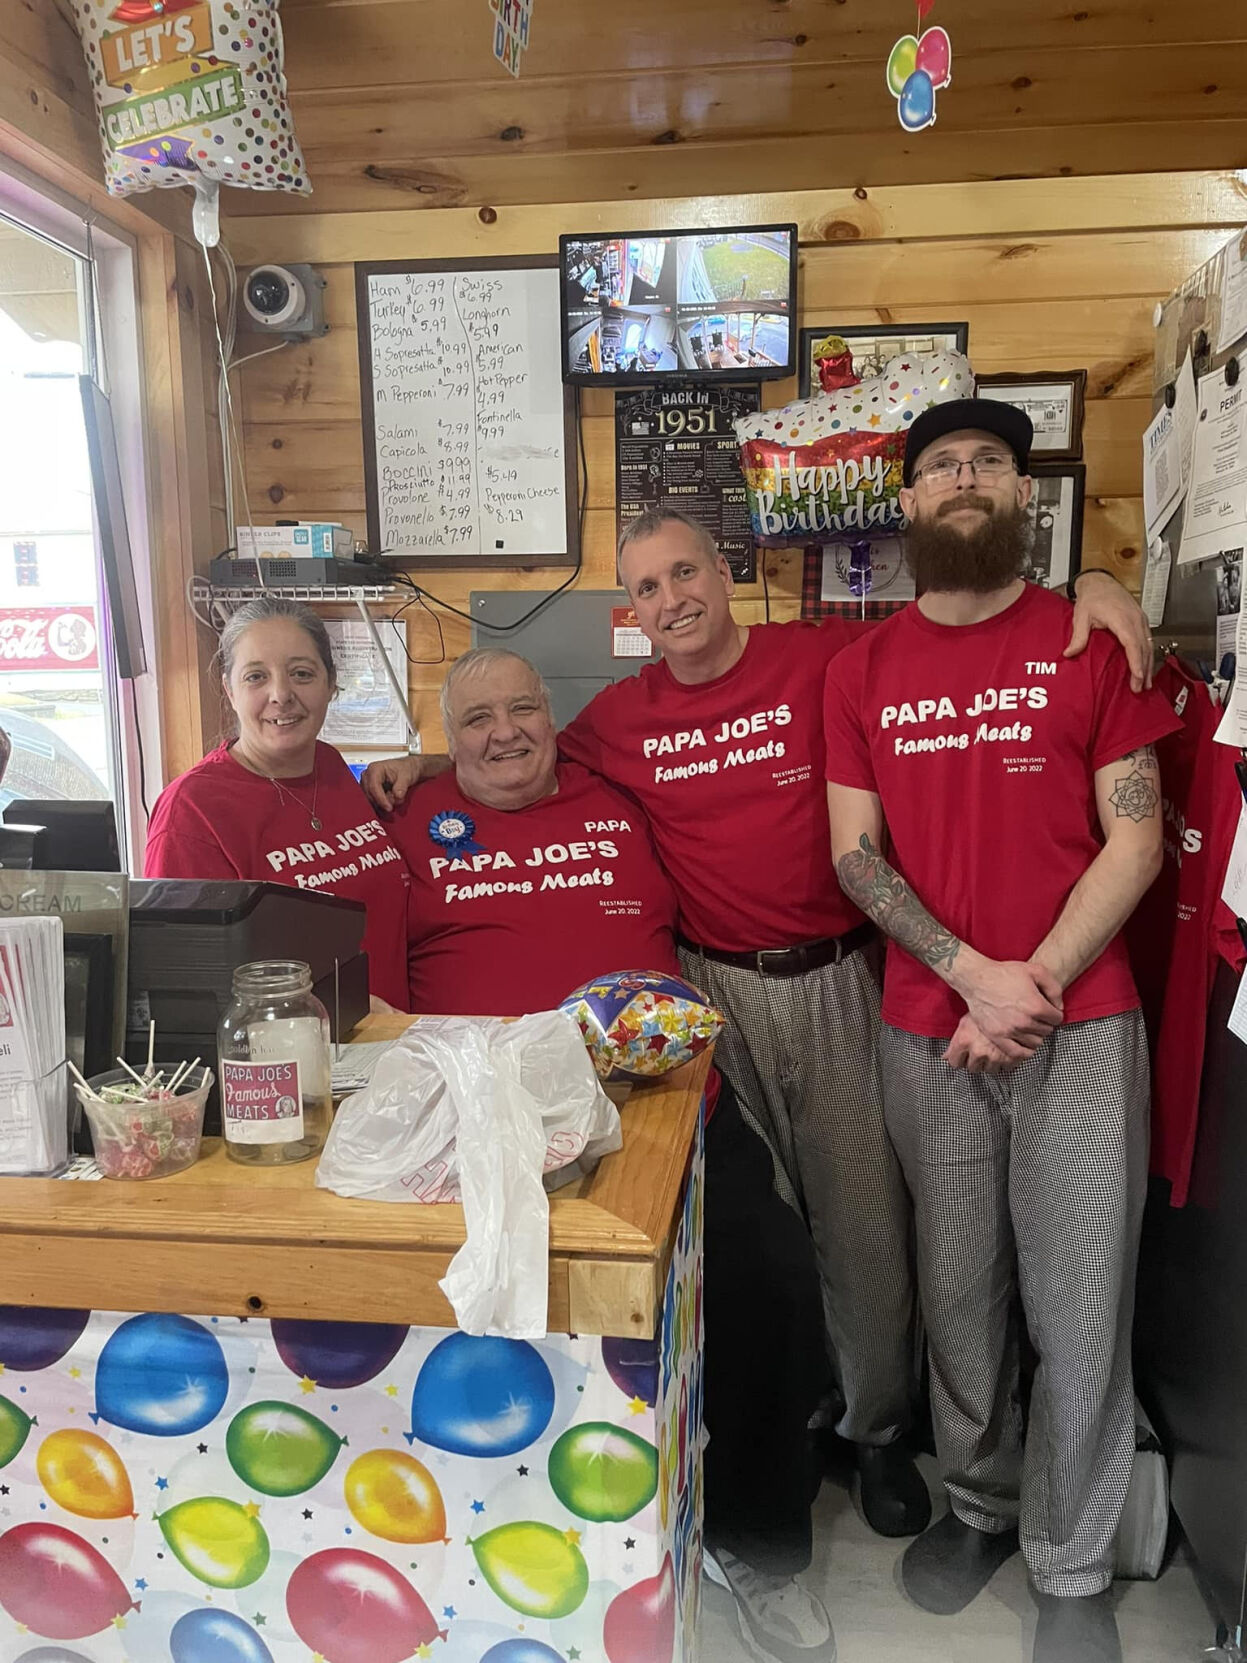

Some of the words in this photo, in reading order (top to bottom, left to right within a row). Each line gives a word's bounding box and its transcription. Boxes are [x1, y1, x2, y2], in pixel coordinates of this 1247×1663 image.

[114, 15, 195, 72] LET'S
[107, 76, 239, 143] CELEBRATE
[370, 281, 401, 298] Ham
[461, 277, 503, 292] Swiss
[369, 299, 406, 324] Turkey
[463, 307, 511, 327] Longhorn
[372, 322, 414, 346] Bologna
[479, 343, 524, 357] American
[391, 384, 437, 404] Pepperoni
[662, 391, 693, 405] BACK
[1220, 388, 1243, 413] PERMIT
[655, 406, 717, 436] 1951
[377, 424, 418, 440] Salami
[380, 442, 428, 459] Capicola
[717, 441, 739, 449] SPORT
[773, 451, 892, 504] Happy
[382, 486, 431, 506] Provolone
[386, 528, 446, 547] Mozzarella
[1025, 661, 1057, 675] TIM
[881, 697, 957, 729] PAPA
[966, 687, 1048, 717] JOE'S
[643, 728, 707, 758] PAPA
[714, 704, 792, 743] JOE'S
[895, 733, 969, 756] Famous
[655, 758, 718, 783] Famous
[723, 740, 785, 768] Meats
[584, 820, 631, 832] PAPA
[266, 841, 335, 872] PAPA
[335, 820, 387, 851] JOE'S
[429, 851, 516, 879] PAPA
[525, 840, 619, 867] JOE'S
[294, 864, 359, 889] Famous
[445, 880, 533, 903] Famous
[540, 867, 614, 892] Meats
[0, 895, 81, 912] CREAM
[225, 1065, 253, 1081] PAPA
[257, 1063, 293, 1082] JOE'S
[226, 1081, 281, 1101] Famous
[226, 1103, 269, 1119] MEATS
